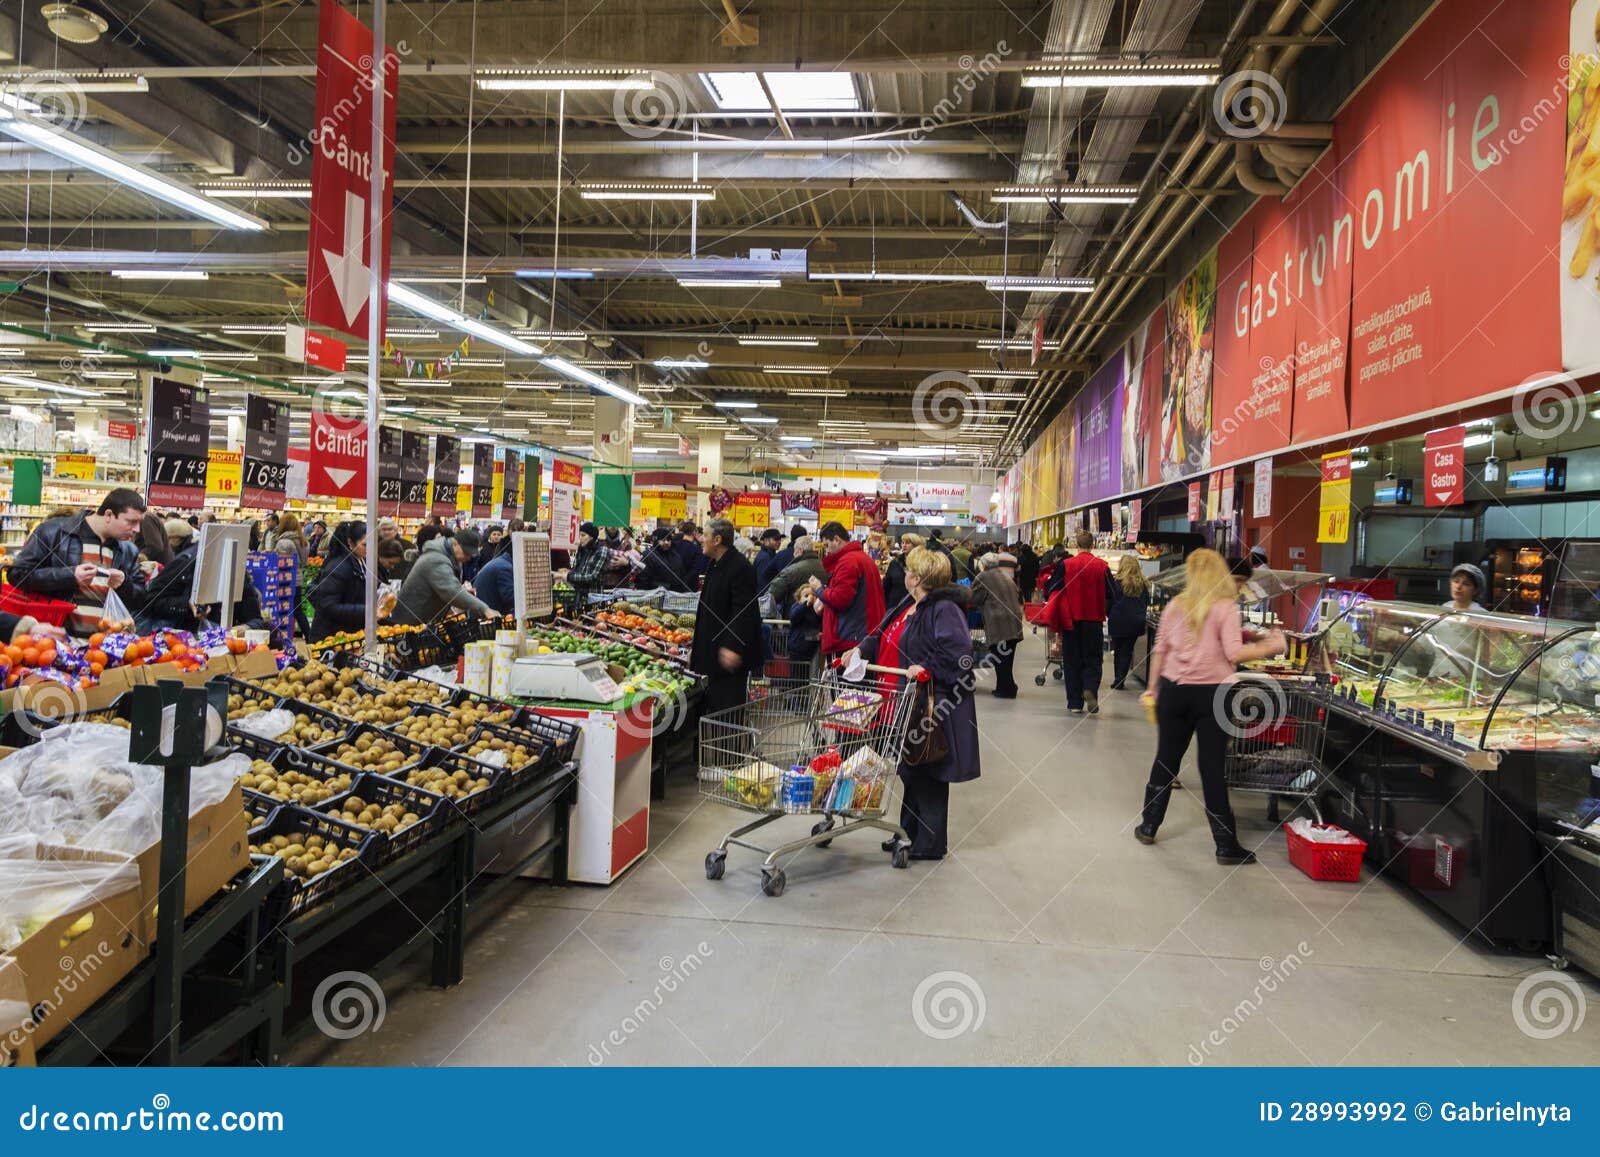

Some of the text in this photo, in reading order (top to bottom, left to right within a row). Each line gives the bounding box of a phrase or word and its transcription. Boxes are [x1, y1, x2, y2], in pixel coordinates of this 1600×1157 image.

[320, 125, 389, 191] Cântr
[1235, 94, 1500, 339] Gastronomie
[315, 425, 367, 457] Cântar
[1434, 452, 1454, 468] Casa
[218, 479, 232, 491] 18
[1431, 472, 1457, 488] Gastro
